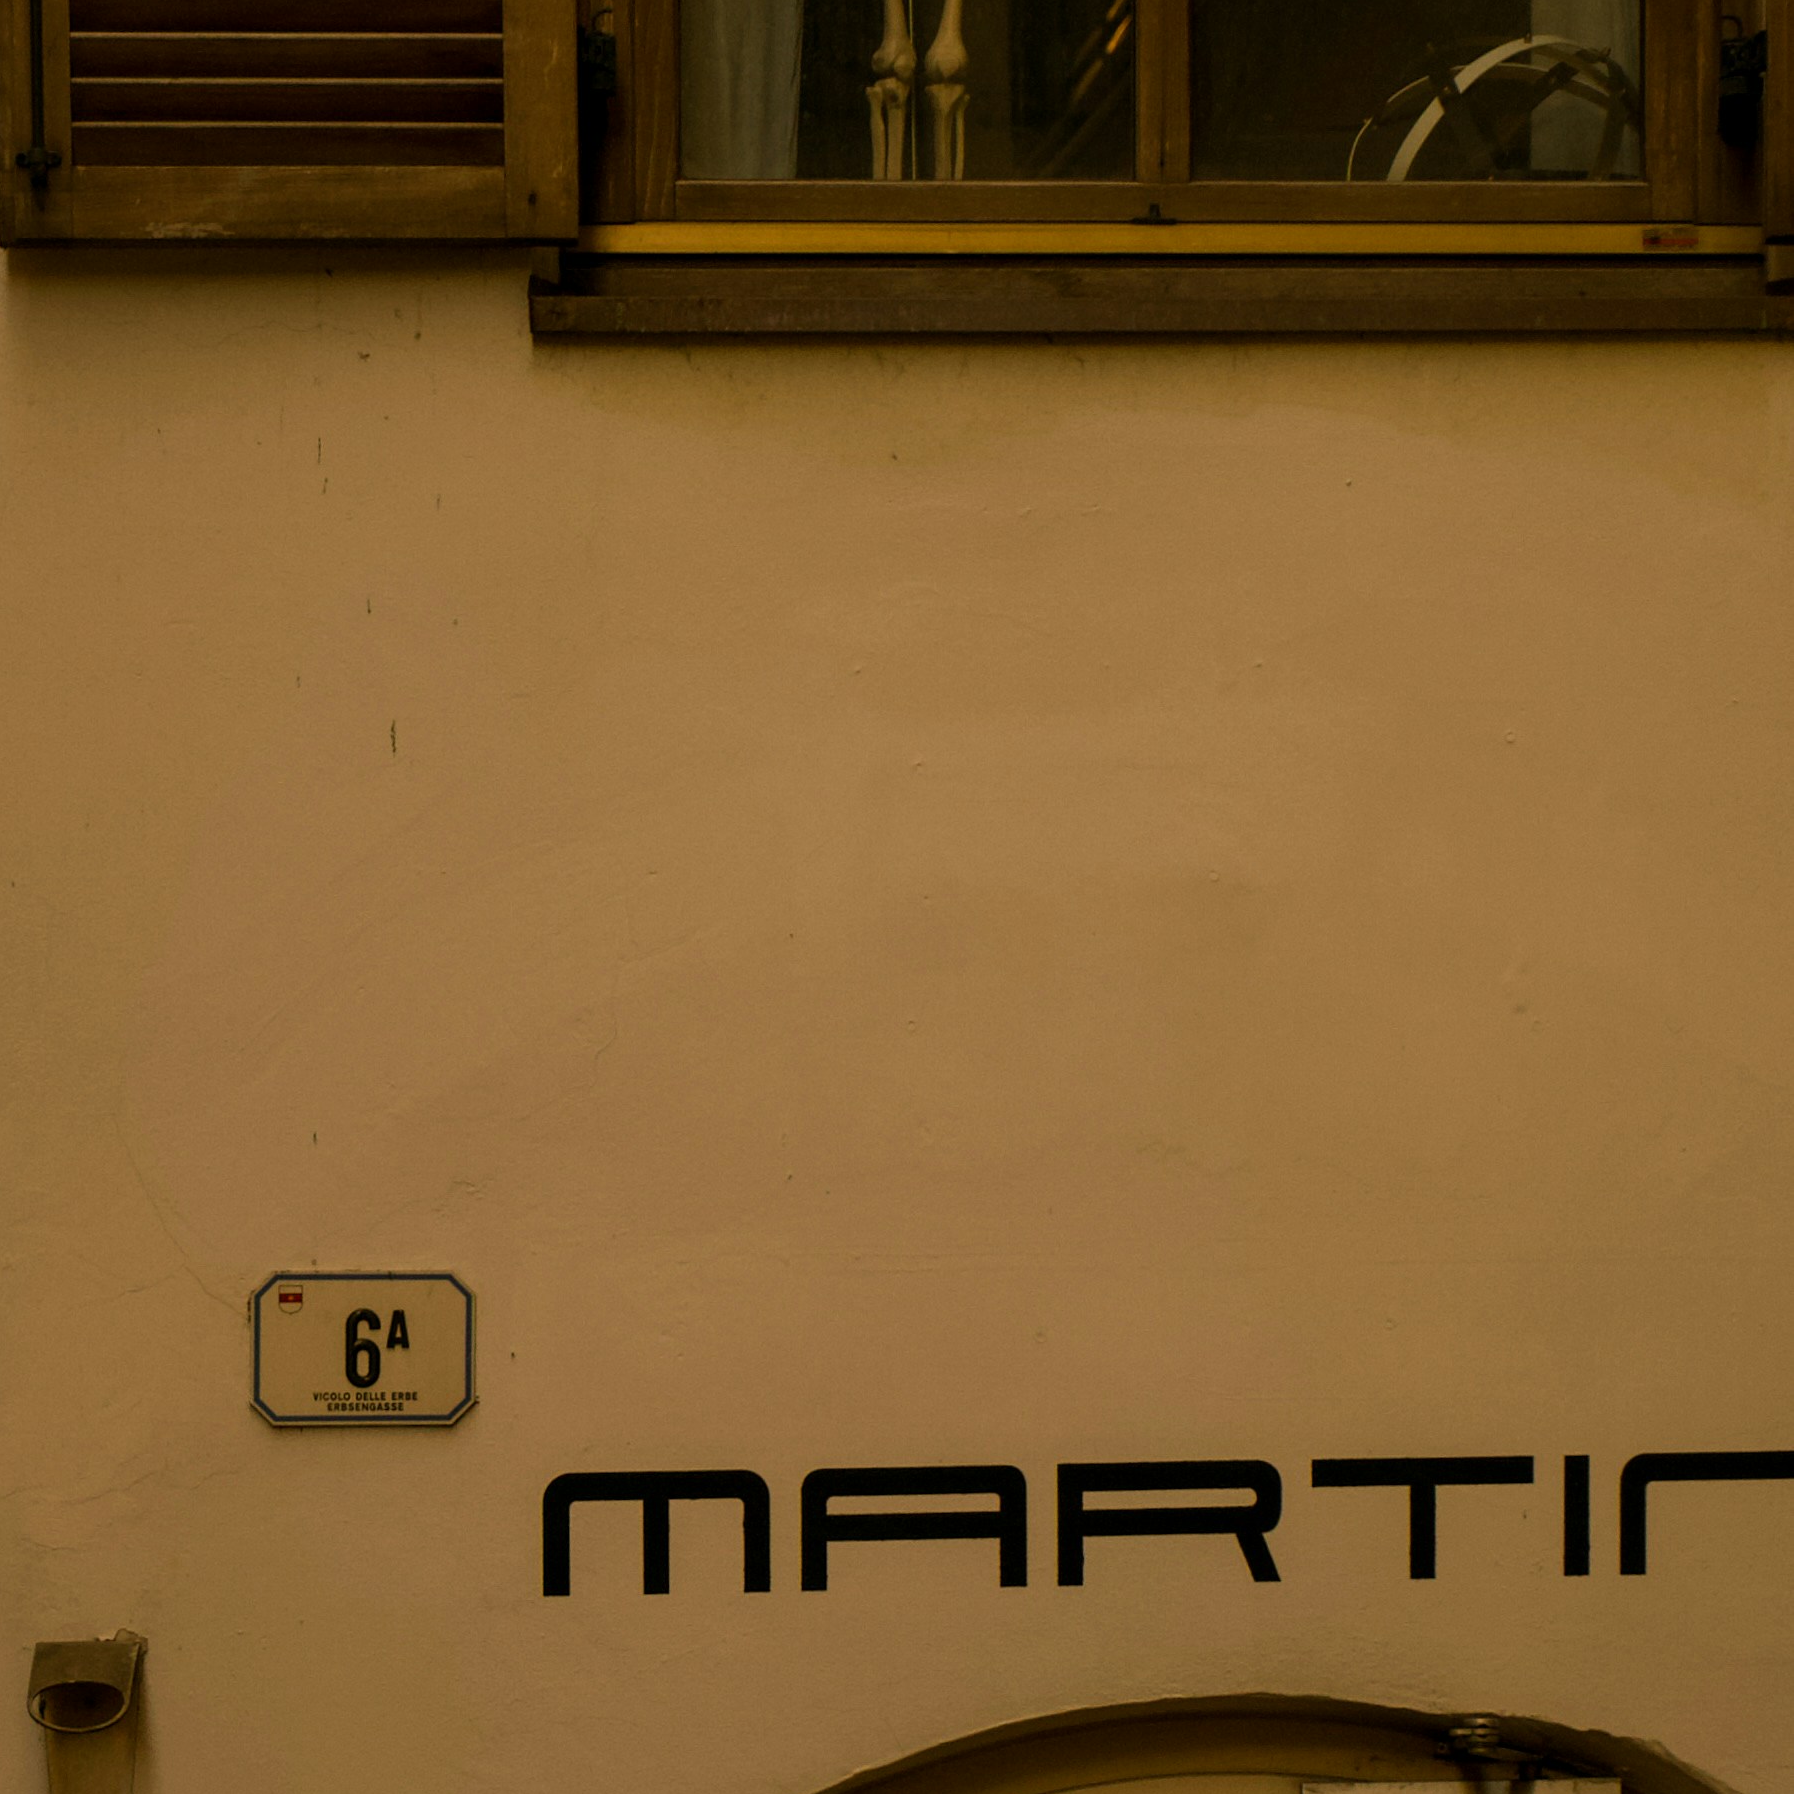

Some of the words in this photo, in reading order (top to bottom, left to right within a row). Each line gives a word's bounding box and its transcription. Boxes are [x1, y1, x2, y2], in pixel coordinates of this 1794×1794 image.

[345, 1307, 410, 1388] 6A
[313, 1392, 351, 1401] VICOLO
[355, 1392, 386, 1401] DELLE
[391, 1392, 418, 1401] ERBE
[327, 1402, 404, 1411] ERBSENGASSE
